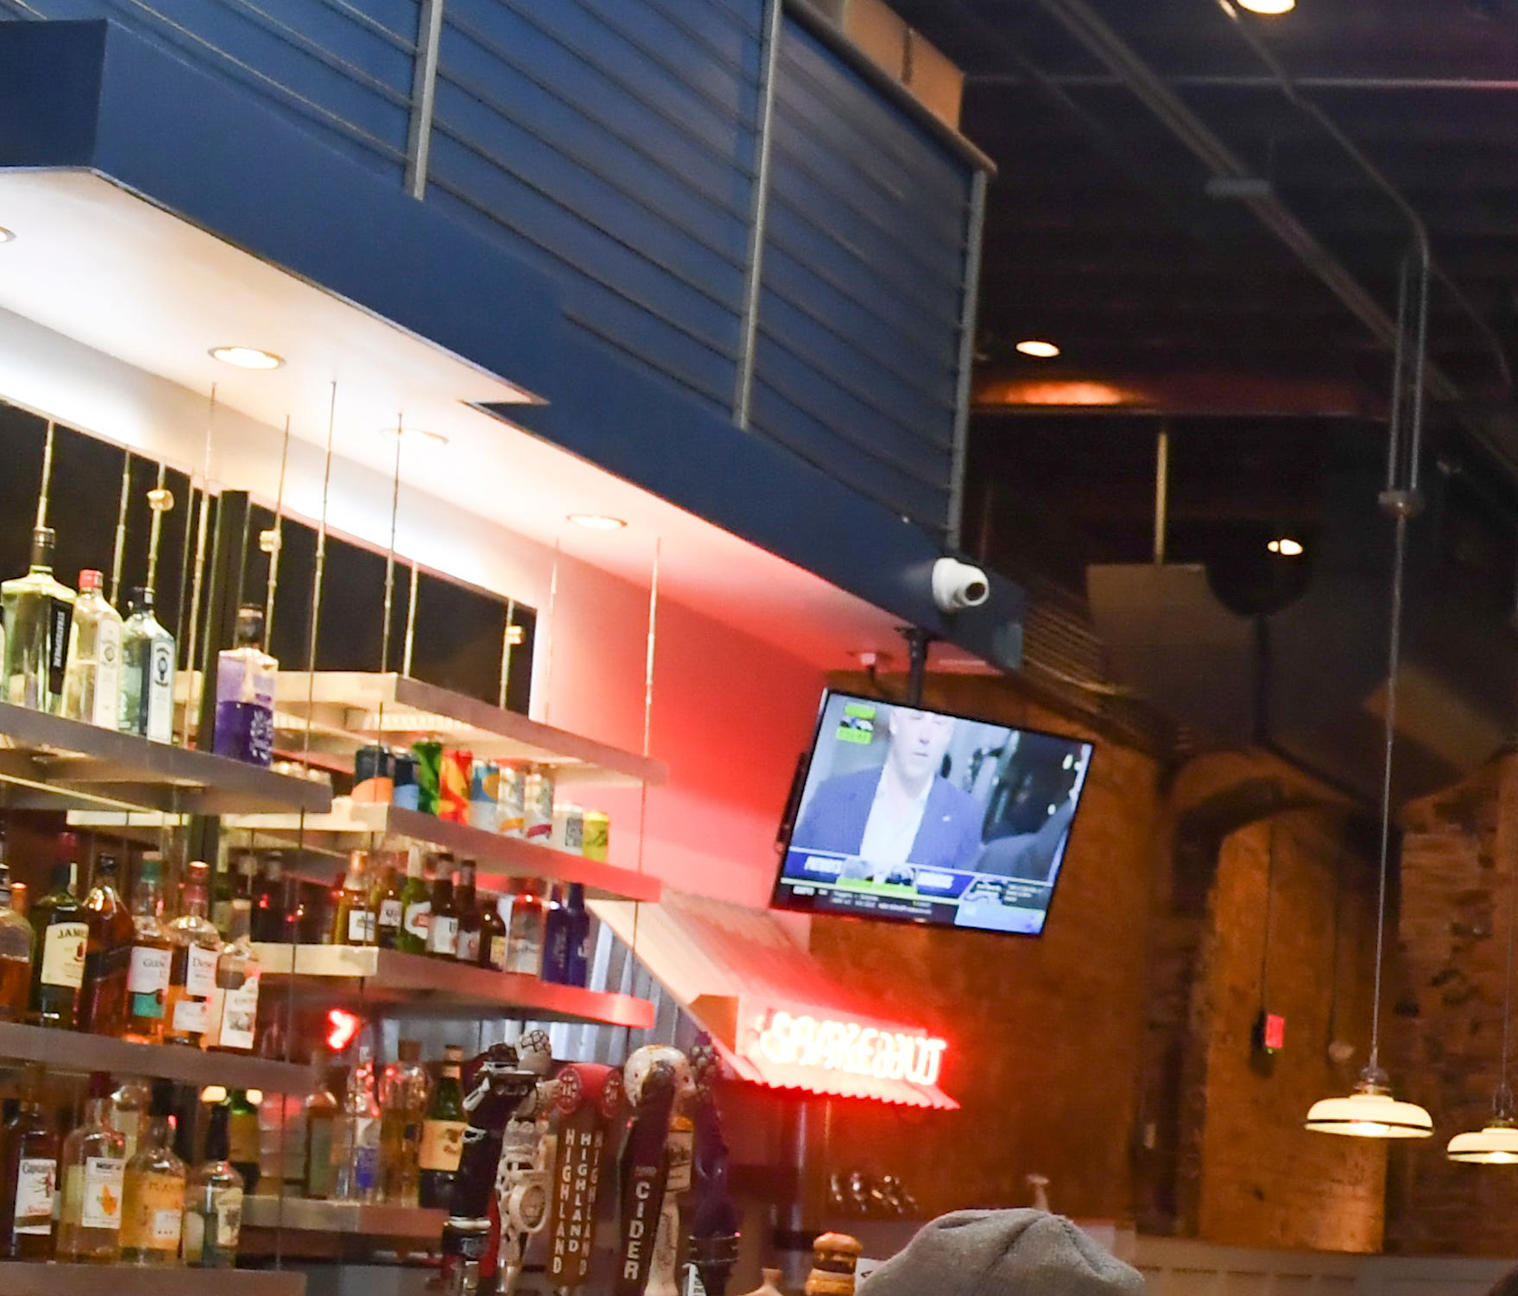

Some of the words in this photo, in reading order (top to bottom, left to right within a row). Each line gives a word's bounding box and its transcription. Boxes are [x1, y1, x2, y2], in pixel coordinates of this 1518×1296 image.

[552, 1128, 576, 1275] HIGHLAND
[568, 1132, 592, 1253] HIGHLAND
[622, 1181, 651, 1281] CIDER
